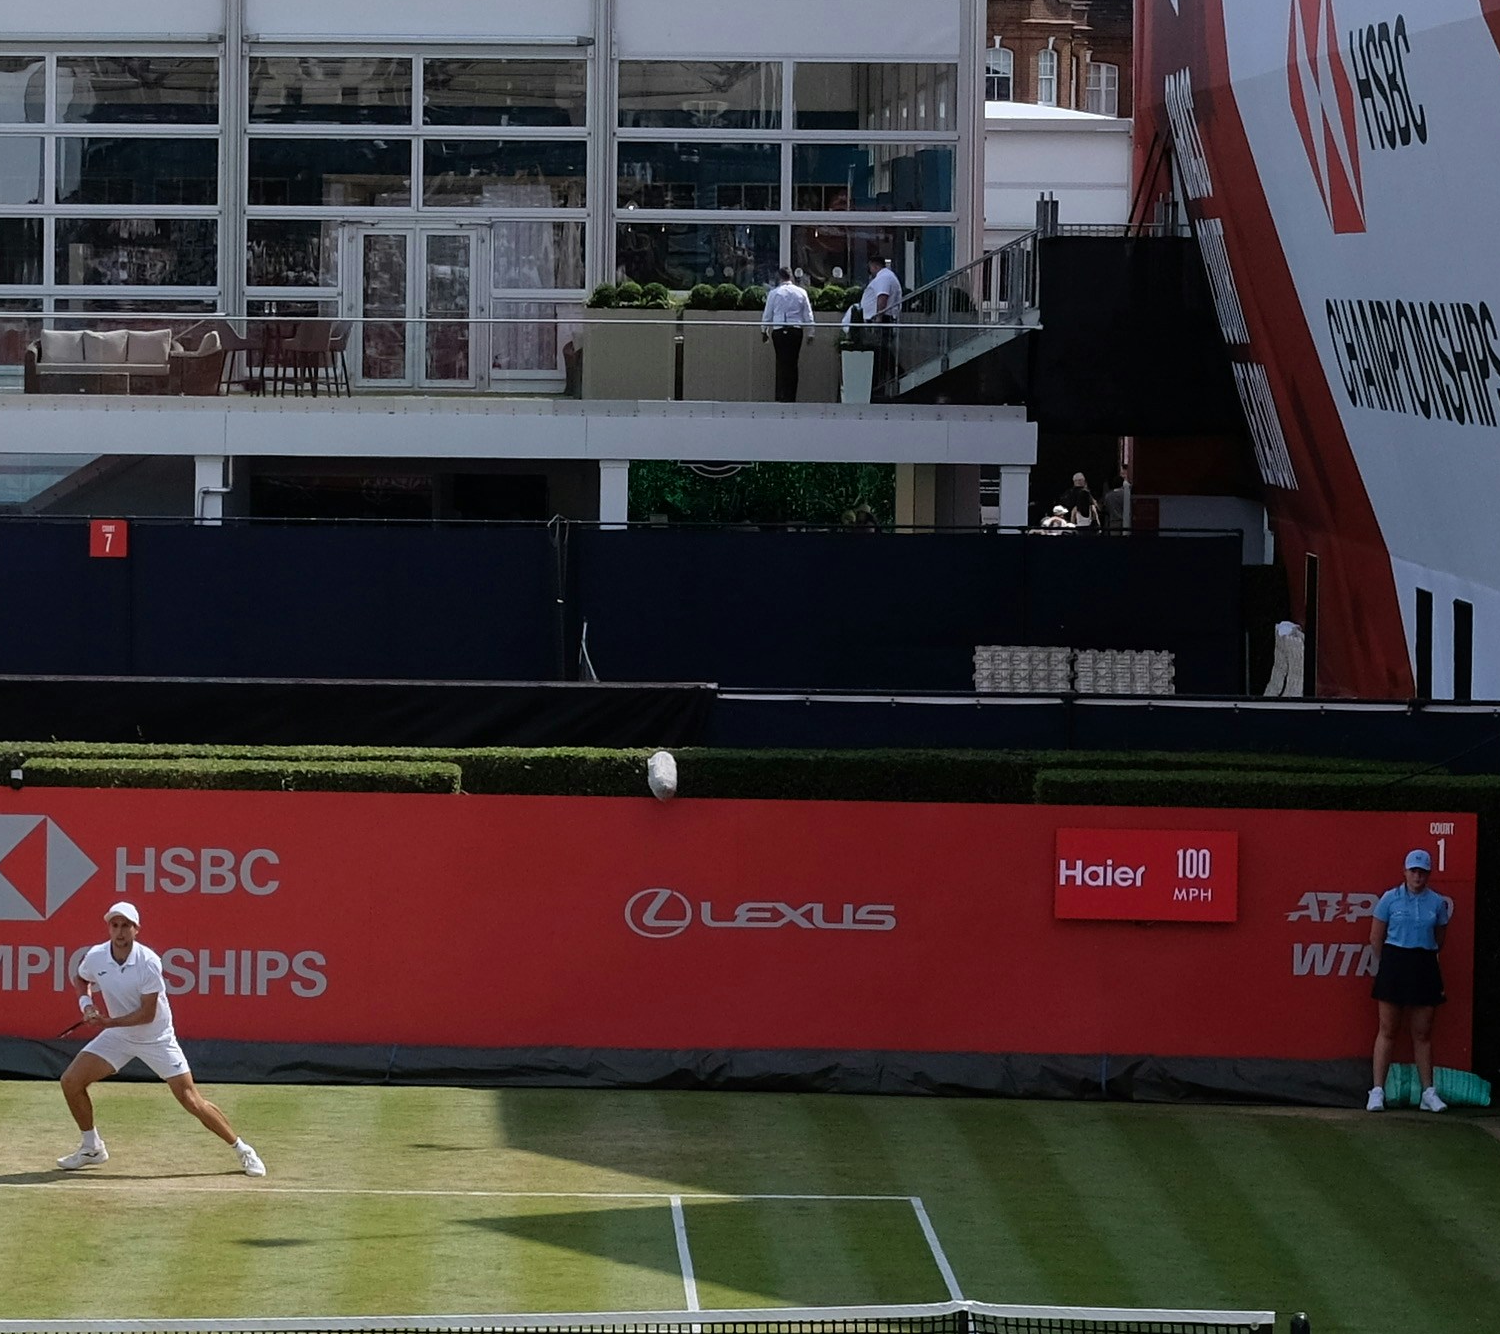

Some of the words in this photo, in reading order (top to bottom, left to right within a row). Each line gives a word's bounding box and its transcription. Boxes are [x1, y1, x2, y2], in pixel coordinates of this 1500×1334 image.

[1347, 14, 1428, 151] HSBC
[104, 533, 112, 553] 7
[1430, 822, 1455, 836] COURT
[1058, 859, 1146, 888] Haier
[1175, 848, 1212, 880] 100
[1437, 837, 1446, 872] 1
[115, 846, 280, 896] HSBC
[1173, 887, 1213, 903] MPH
[702, 902, 896, 932] LEXUS
